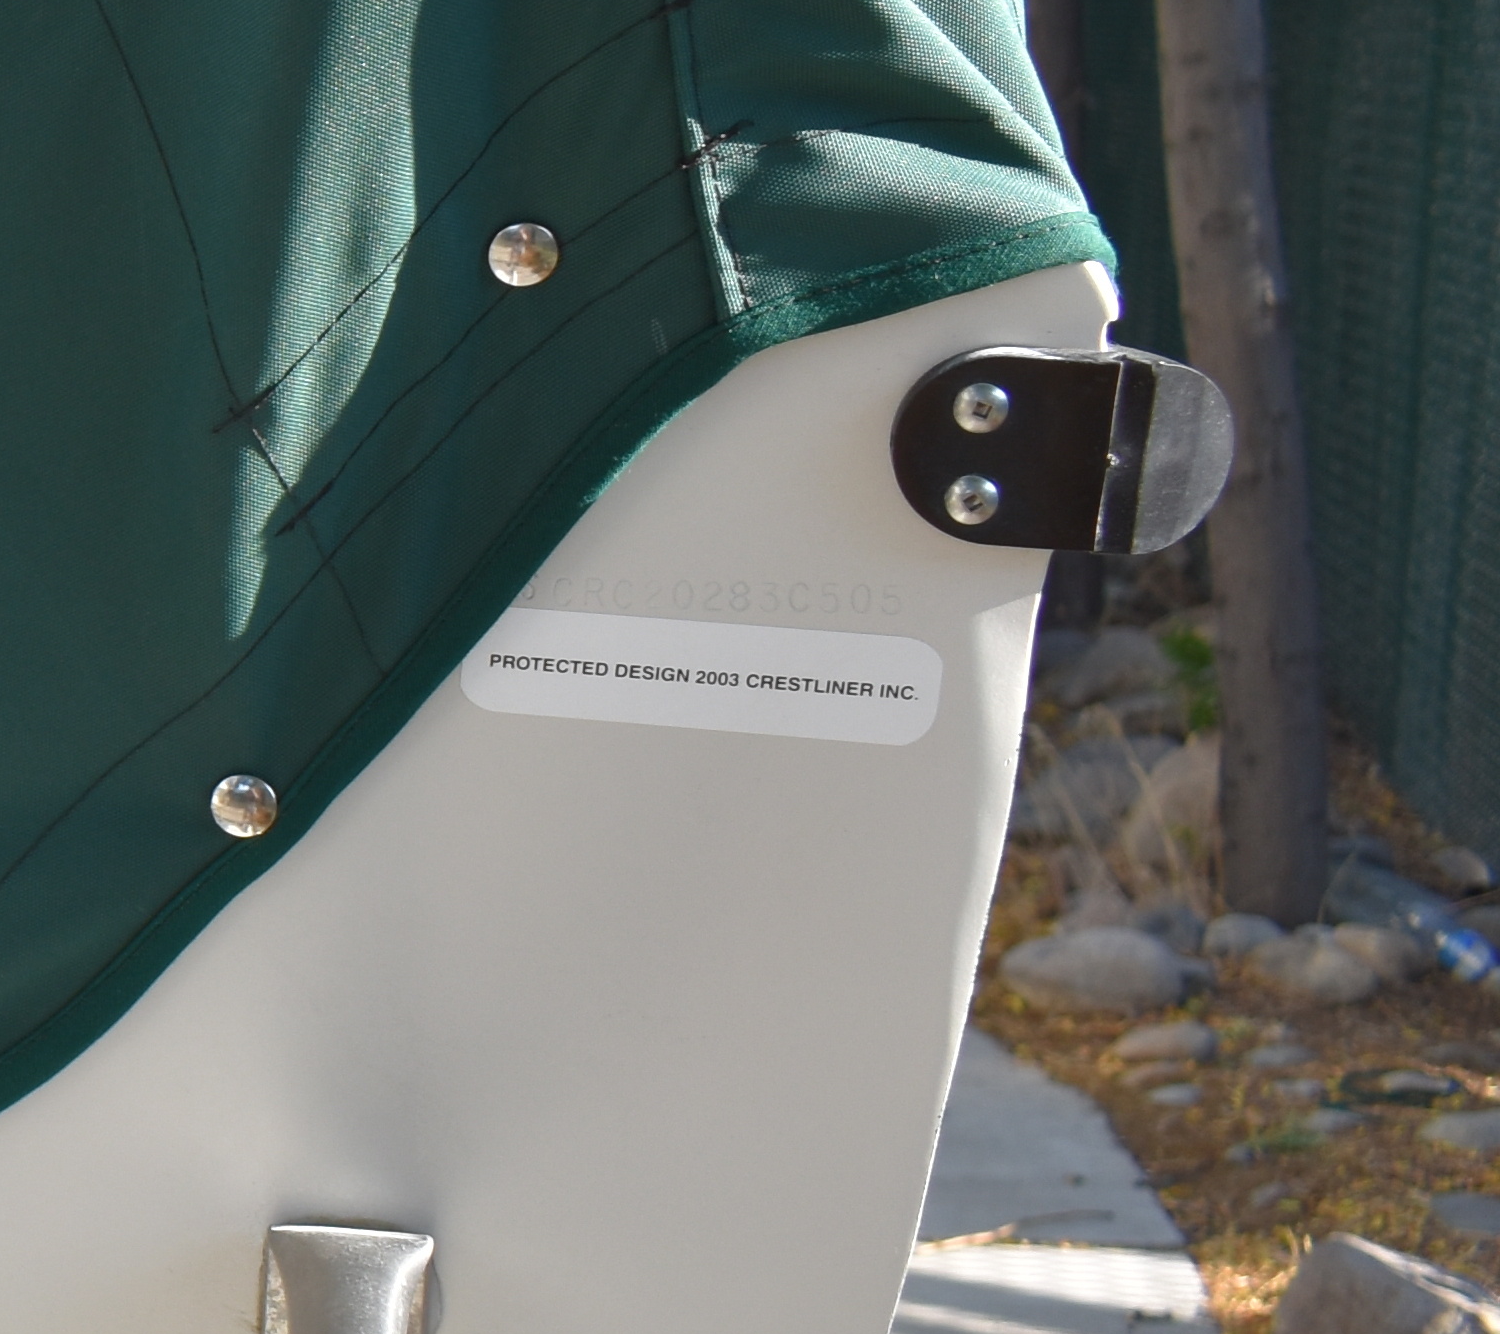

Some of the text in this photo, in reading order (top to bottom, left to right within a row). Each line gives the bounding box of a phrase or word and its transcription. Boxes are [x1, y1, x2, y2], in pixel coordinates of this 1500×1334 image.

[488, 653, 921, 701] PROTECTED DESIGN 2003 CRESTLINER INC.
